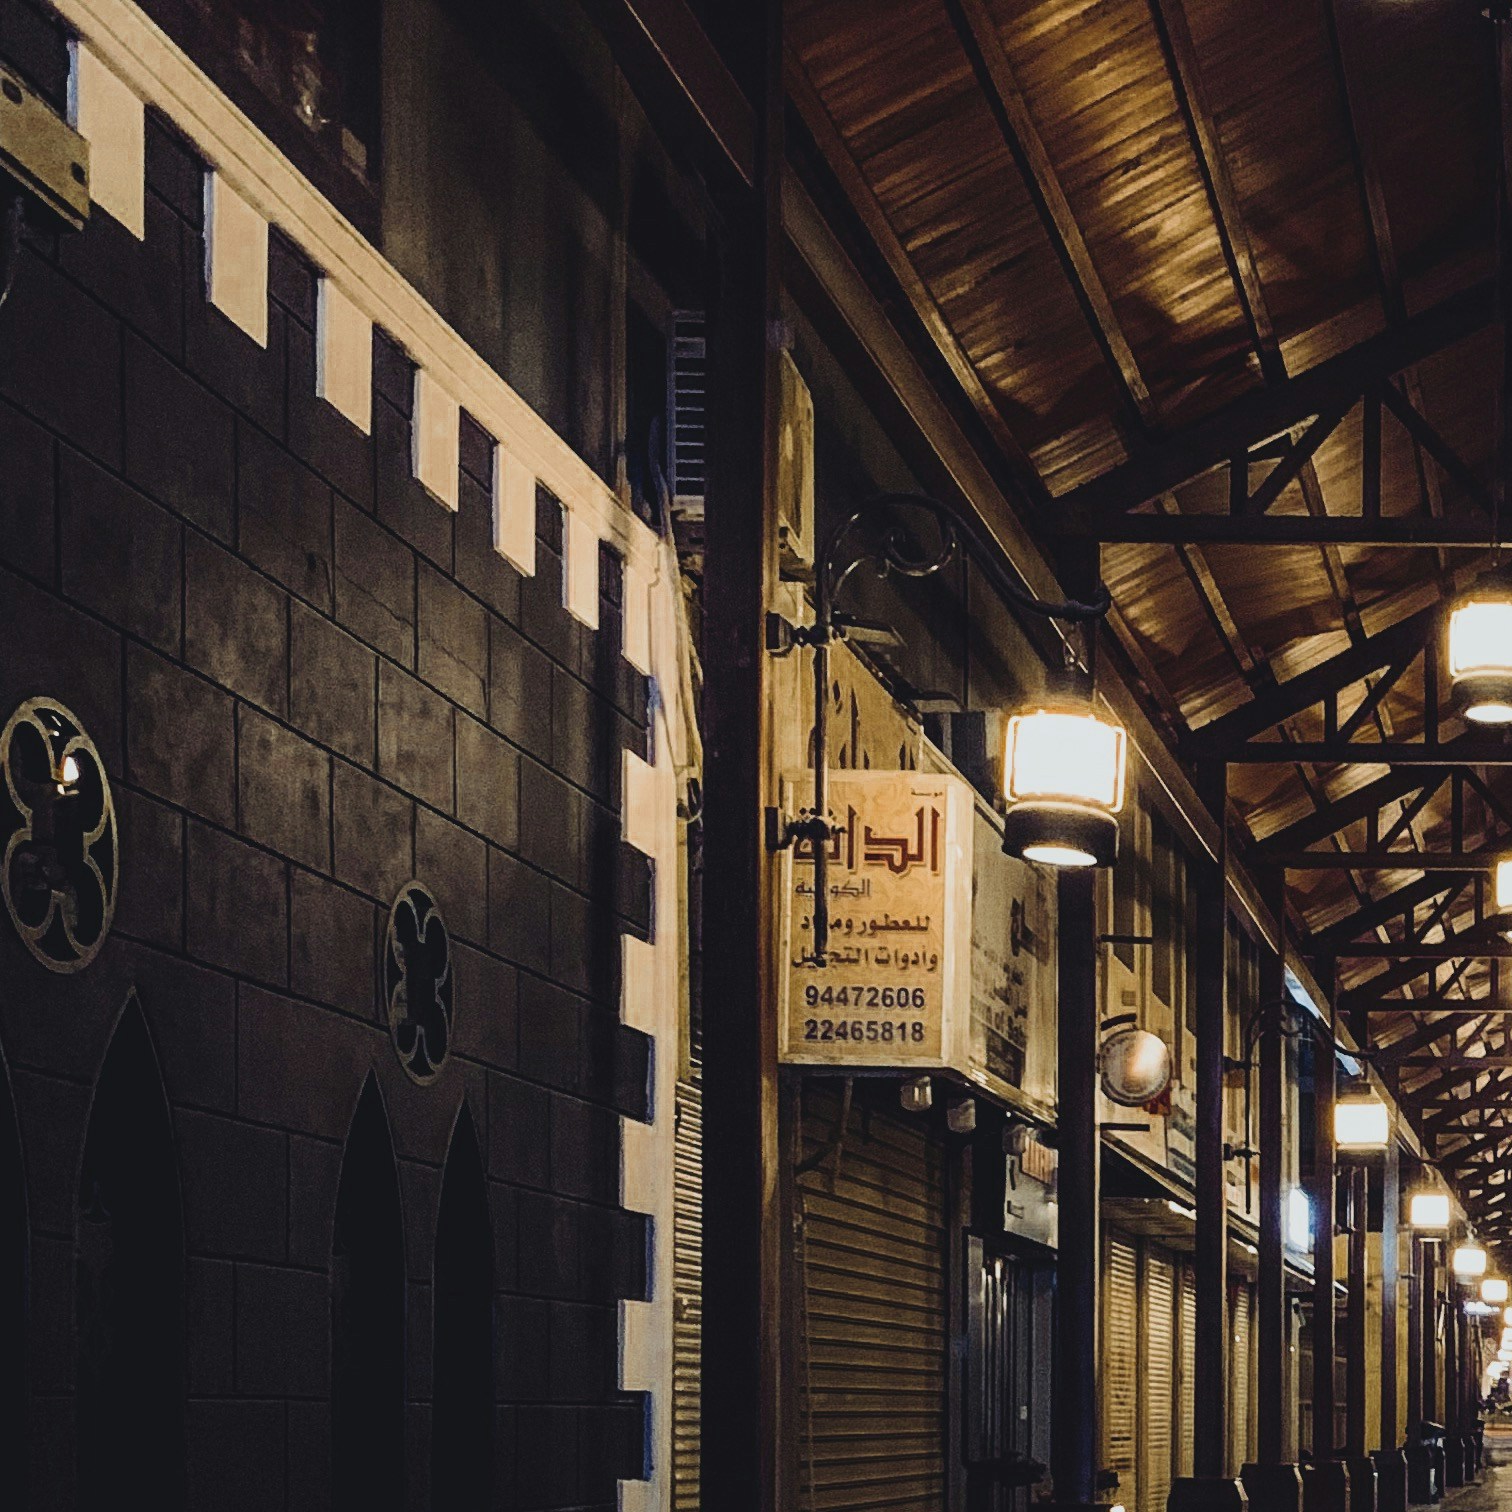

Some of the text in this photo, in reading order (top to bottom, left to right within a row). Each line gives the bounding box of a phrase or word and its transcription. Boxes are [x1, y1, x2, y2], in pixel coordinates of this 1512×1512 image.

[857, 913, 930, 937] للعطور
[792, 946, 868, 969] التجيل
[805, 985, 925, 1009] 94472606
[804, 1018, 924, 1042] 22465818
